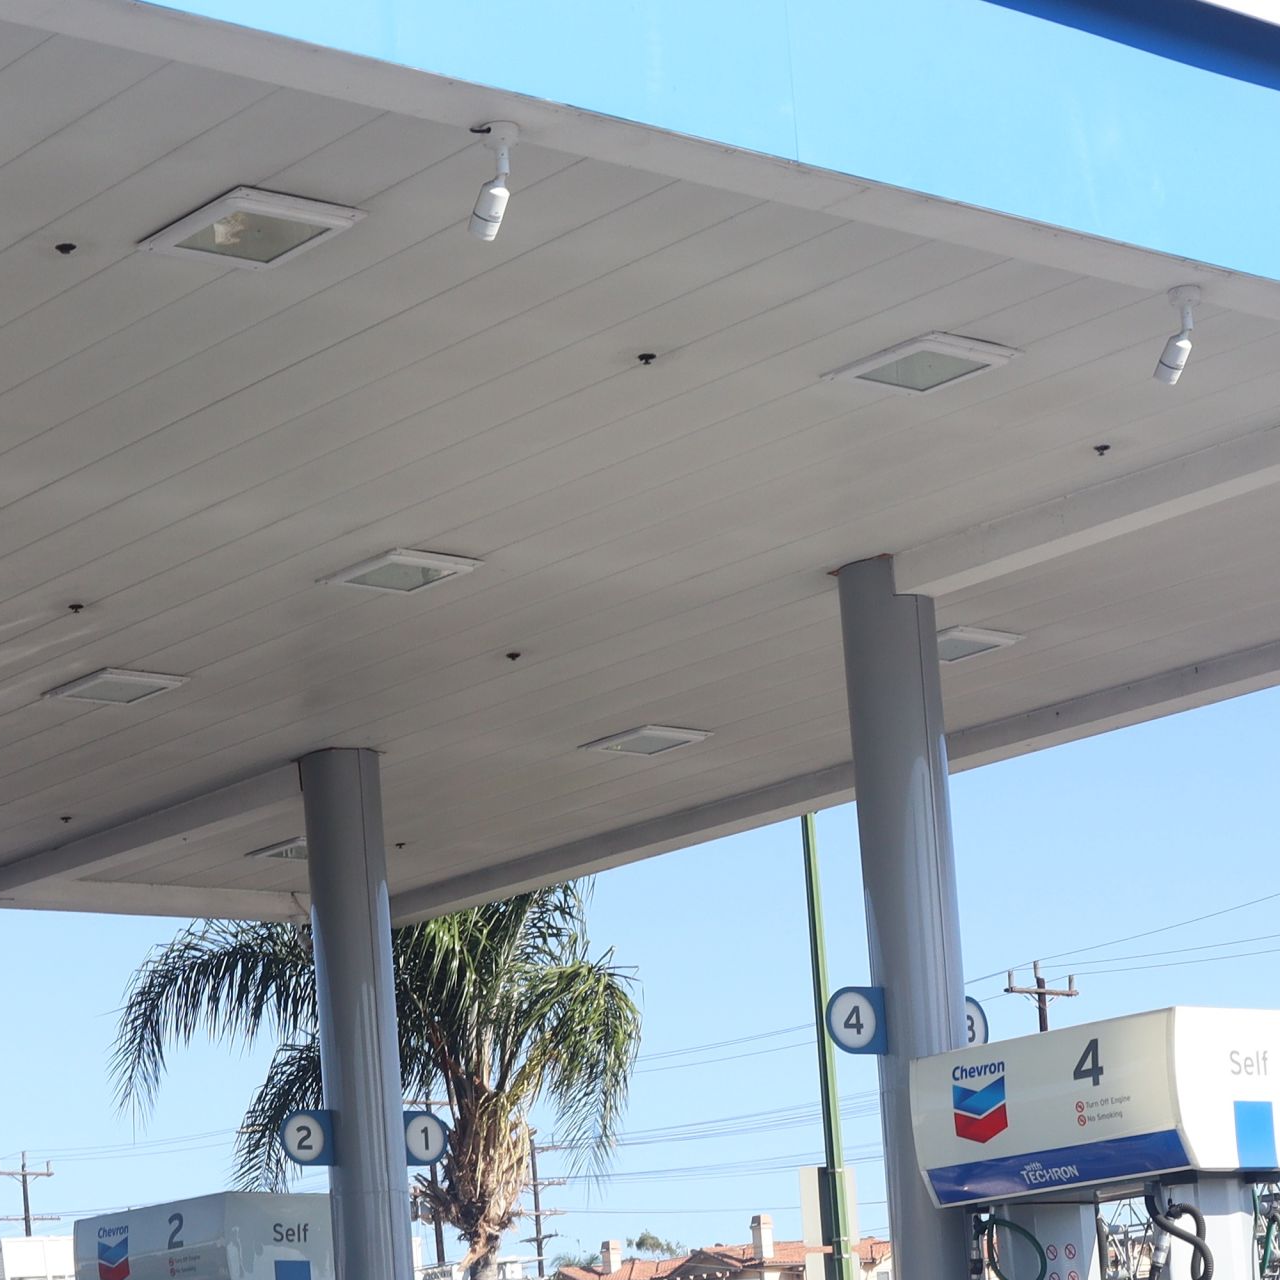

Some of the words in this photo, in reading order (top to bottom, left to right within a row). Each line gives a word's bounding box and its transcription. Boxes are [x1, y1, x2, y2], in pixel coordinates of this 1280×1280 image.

[843, 1005, 865, 1036] 4
[966, 1014, 976, 1043] 3
[951, 1060, 1005, 1081] Chevron
[1073, 1037, 1104, 1087] 4
[1229, 1048, 1270, 1078] Self
[1085, 1101, 1099, 1109] Turn
[1100, 1098, 1110, 1106] Off
[1111, 1095, 1131, 1104] Engine
[1087, 1114, 1096, 1122] No
[1097, 1111, 1123, 1121] Smoking
[297, 1126, 314, 1151] 2
[421, 1126, 430, 1151] 1
[1020, 1165, 1080, 1185] TECHRON
[1024, 1161, 1043, 1171] with
[97, 1224, 129, 1239] Chevron
[167, 1212, 184, 1250] 2
[272, 1222, 310, 1243] Self
